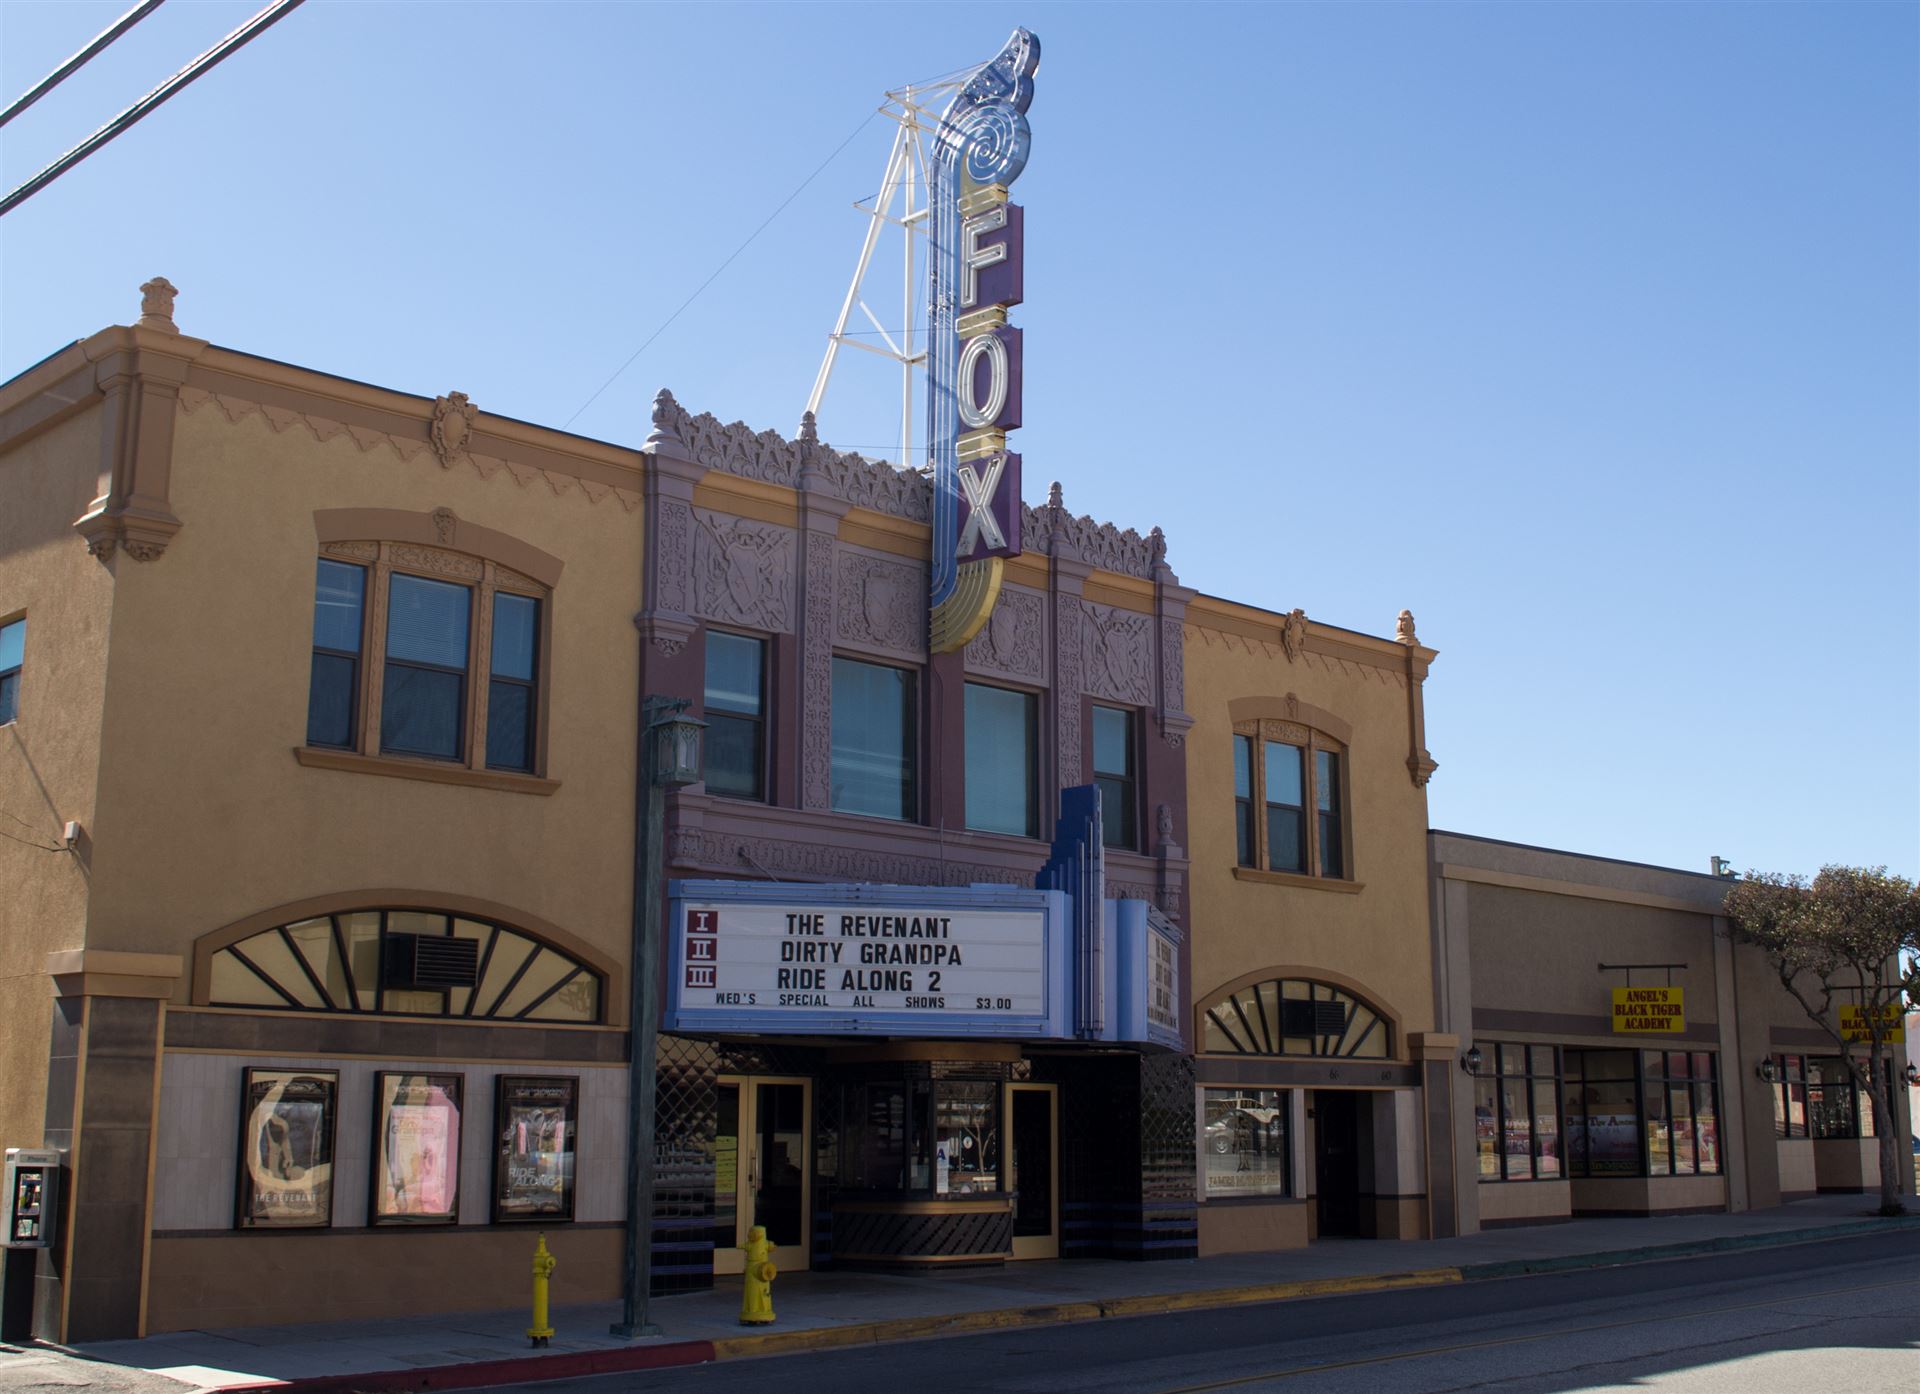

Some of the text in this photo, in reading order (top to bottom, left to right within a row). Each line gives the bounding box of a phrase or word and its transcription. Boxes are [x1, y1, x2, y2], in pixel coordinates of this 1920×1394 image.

[955, 205, 1008, 558] FOX
[786, 913, 951, 939] THE REVENANT
[781, 941, 962, 966] DIRTY GRANDPA
[777, 968, 941, 992] RIDE ALONG 2
[716, 992, 756, 1005] WED'S
[779, 993, 829, 1006] SPECIAL
[853, 995, 875, 1007] ALL
[905, 996, 945, 1008] SHOWS
[1626, 990, 1668, 1002] ANGEL'S
[1615, 1004, 1681, 1016] BLACK TIGER
[1624, 1018, 1672, 1029] ACADEMY
